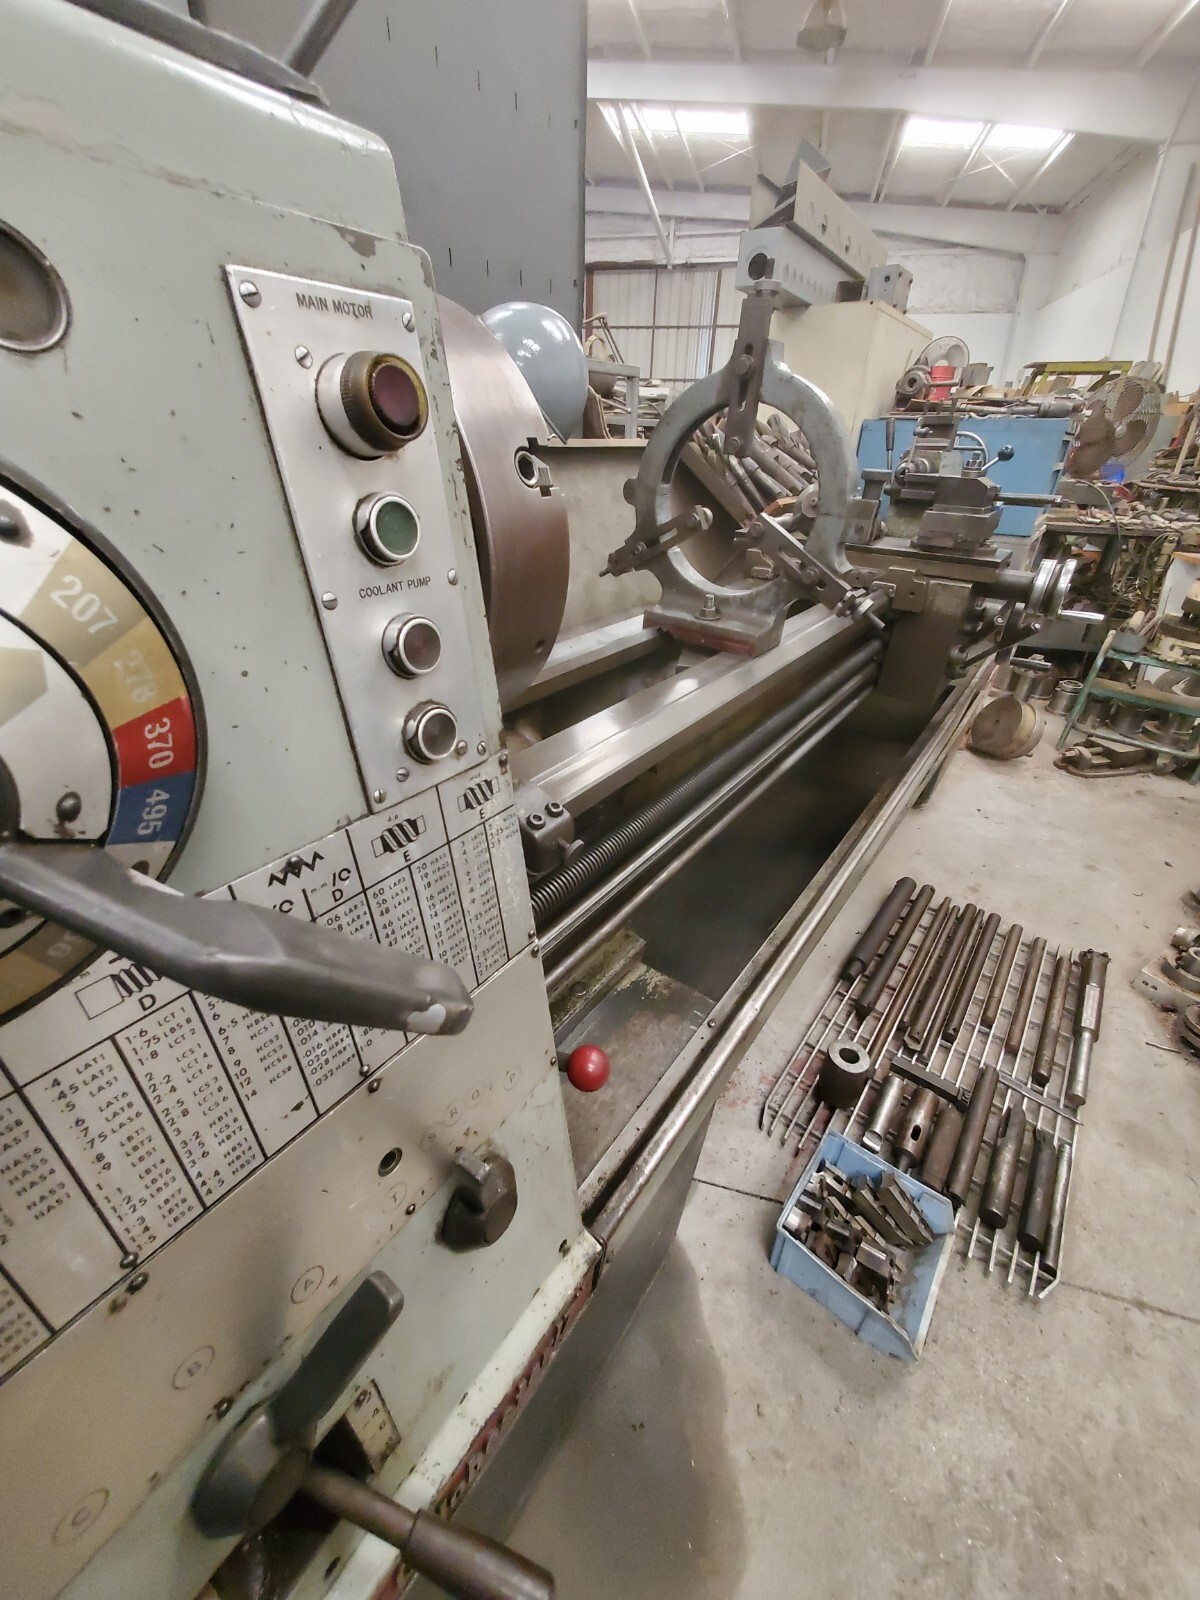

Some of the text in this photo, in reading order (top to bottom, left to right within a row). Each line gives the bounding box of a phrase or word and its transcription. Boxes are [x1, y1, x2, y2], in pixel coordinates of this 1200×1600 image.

[296, 292, 373, 319] MAIN MOTOR
[359, 576, 431, 598] COOLANT PUMP
[50, 575, 119, 634] 207
[144, 717, 174, 769] 370
[137, 788, 170, 835] 495
[403, 850, 411, 862] E
[416, 862, 428, 874] 20
[420, 872, 429, 882] 19
[332, 889, 344, 902] D
[372, 888, 384, 900] 60
[426, 895, 434, 903] 16
[376, 898, 388, 908] 56
[380, 907, 390, 916] 48
[382, 920, 393, 930] 46
[385, 928, 396, 939] 44
[138, 994, 156, 1011] D
[212, 1012, 220, 1020] 6
[223, 1036, 229, 1045] 7
[228, 1046, 235, 1055] 8
[234, 1059, 241, 1068] 9
[145, 1072, 154, 1082] 2
[234, 1068, 247, 1080] 10
[240, 1077, 252, 1089] 12
[245, 1089, 257, 1101] 14
[173, 1128, 182, 1137] 3
